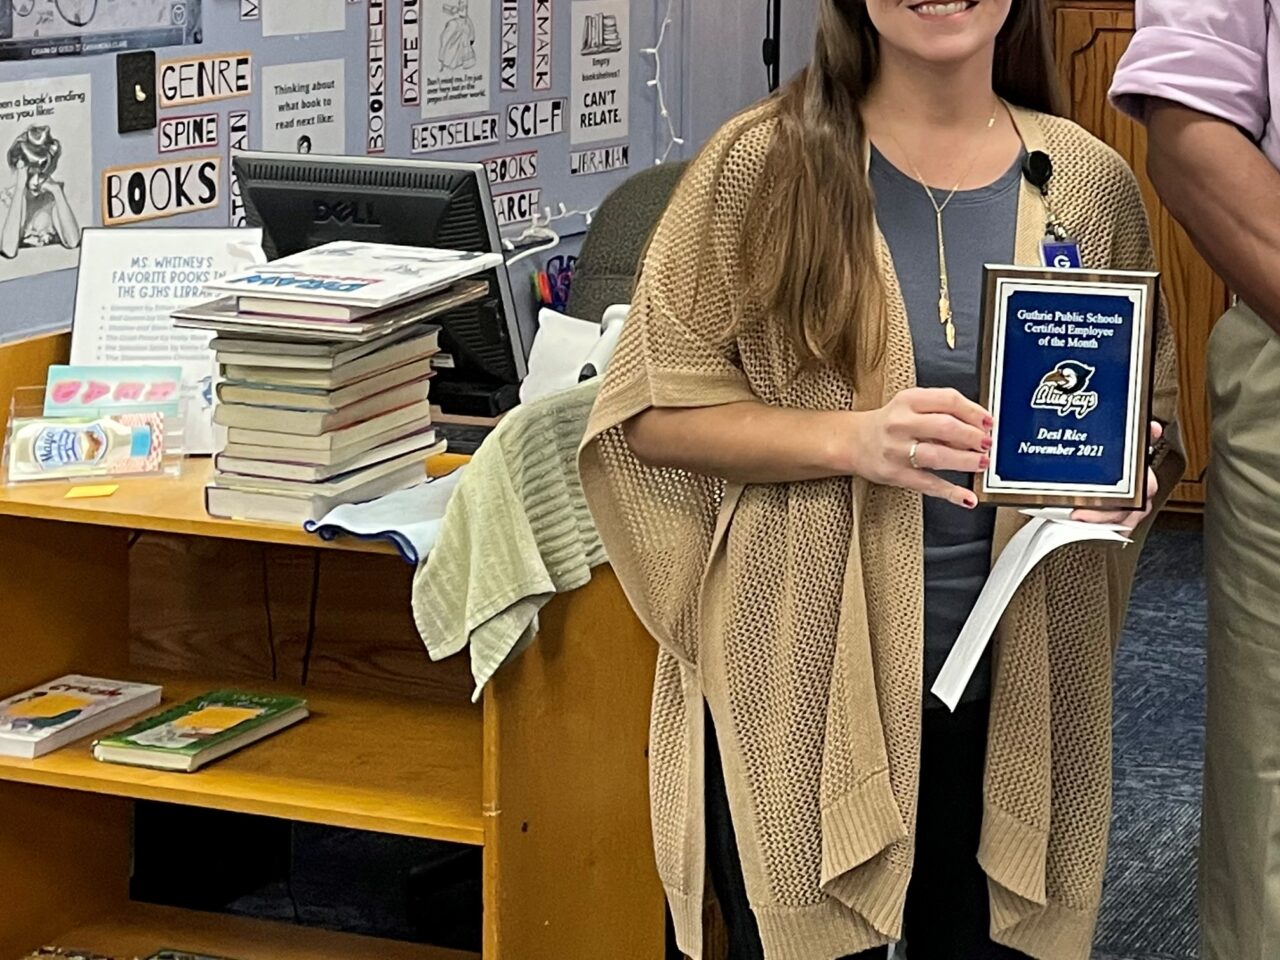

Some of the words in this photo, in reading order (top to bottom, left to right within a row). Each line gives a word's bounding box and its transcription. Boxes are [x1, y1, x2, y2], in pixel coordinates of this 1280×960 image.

[404, 37, 419, 103] DATE
[162, 58, 249, 101] GENRE
[274, 83, 309, 97] Thinking
[312, 80, 336, 91] about
[23, 93, 53, 106] book's
[55, 90, 85, 103] ending
[278, 99, 297, 111] what
[300, 97, 321, 109] book
[323, 97, 332, 107] to
[584, 90, 616, 108] CAN'T
[16, 109, 34, 122] you
[275, 118, 295, 131] read
[296, 116, 315, 128] next
[580, 109, 621, 128] RELATE.
[162, 118, 216, 149] SPINE
[413, 116, 498, 148] BESTSELLER
[489, 154, 536, 182] BOOKS
[571, 146, 628, 174] LIBRARIAN
[107, 161, 217, 219] BOOKS
[313, 200, 382, 224] DELL
[497, 191, 540, 221] ARCH
[155, 256, 213, 269] WHITNEY'S
[1053, 255, 1071, 268] G
[112, 271, 166, 283] FAVORITE
[170, 271, 210, 283] BOOKS
[118, 287, 135, 298] THE
[139, 286, 170, 298] GJHS
[1017, 309, 1053, 321] Guthrie
[1055, 311, 1084, 322] Public
[1086, 312, 1122, 324] Schools
[1024, 323, 1066, 335] Certified
[1068, 324, 1114, 338] Employee
[1038, 336, 1050, 346] of
[1051, 337, 1065, 347] the
[1067, 337, 1098, 348] Month
[1037, 428, 1062, 440] Desi
[1063, 429, 1088, 441] Rice
[1018, 442, 1076, 455] November
[1077, 445, 1103, 456] 2021
